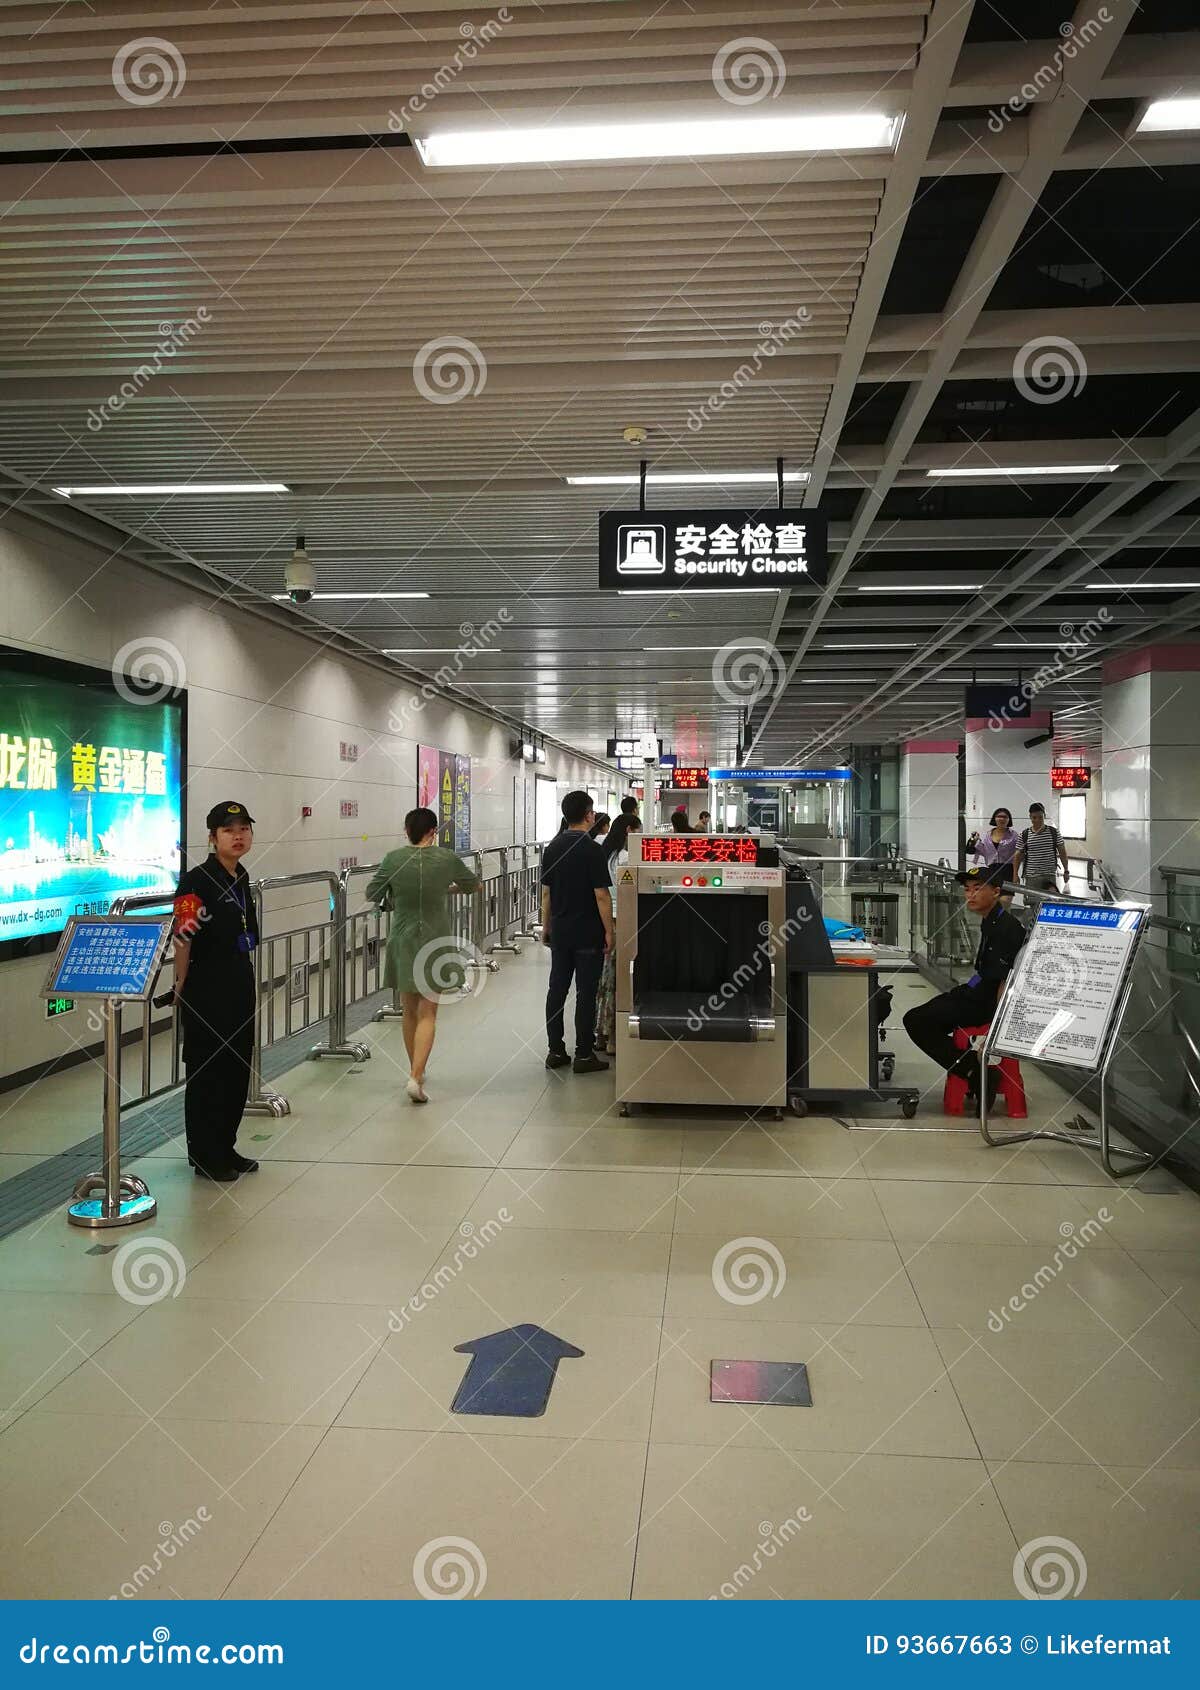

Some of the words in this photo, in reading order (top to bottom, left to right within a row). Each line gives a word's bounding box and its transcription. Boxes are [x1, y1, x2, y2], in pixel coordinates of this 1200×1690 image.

[674, 523, 807, 555] 安全检查
[674, 558, 748, 576] Security
[752, 557, 808, 573] Check
[641, 838, 757, 862] 请接受安检
[0, 907, 62, 925] ww.dx-dg.com
[1040, 908, 1122, 922] 轨道交通禁止携带的
